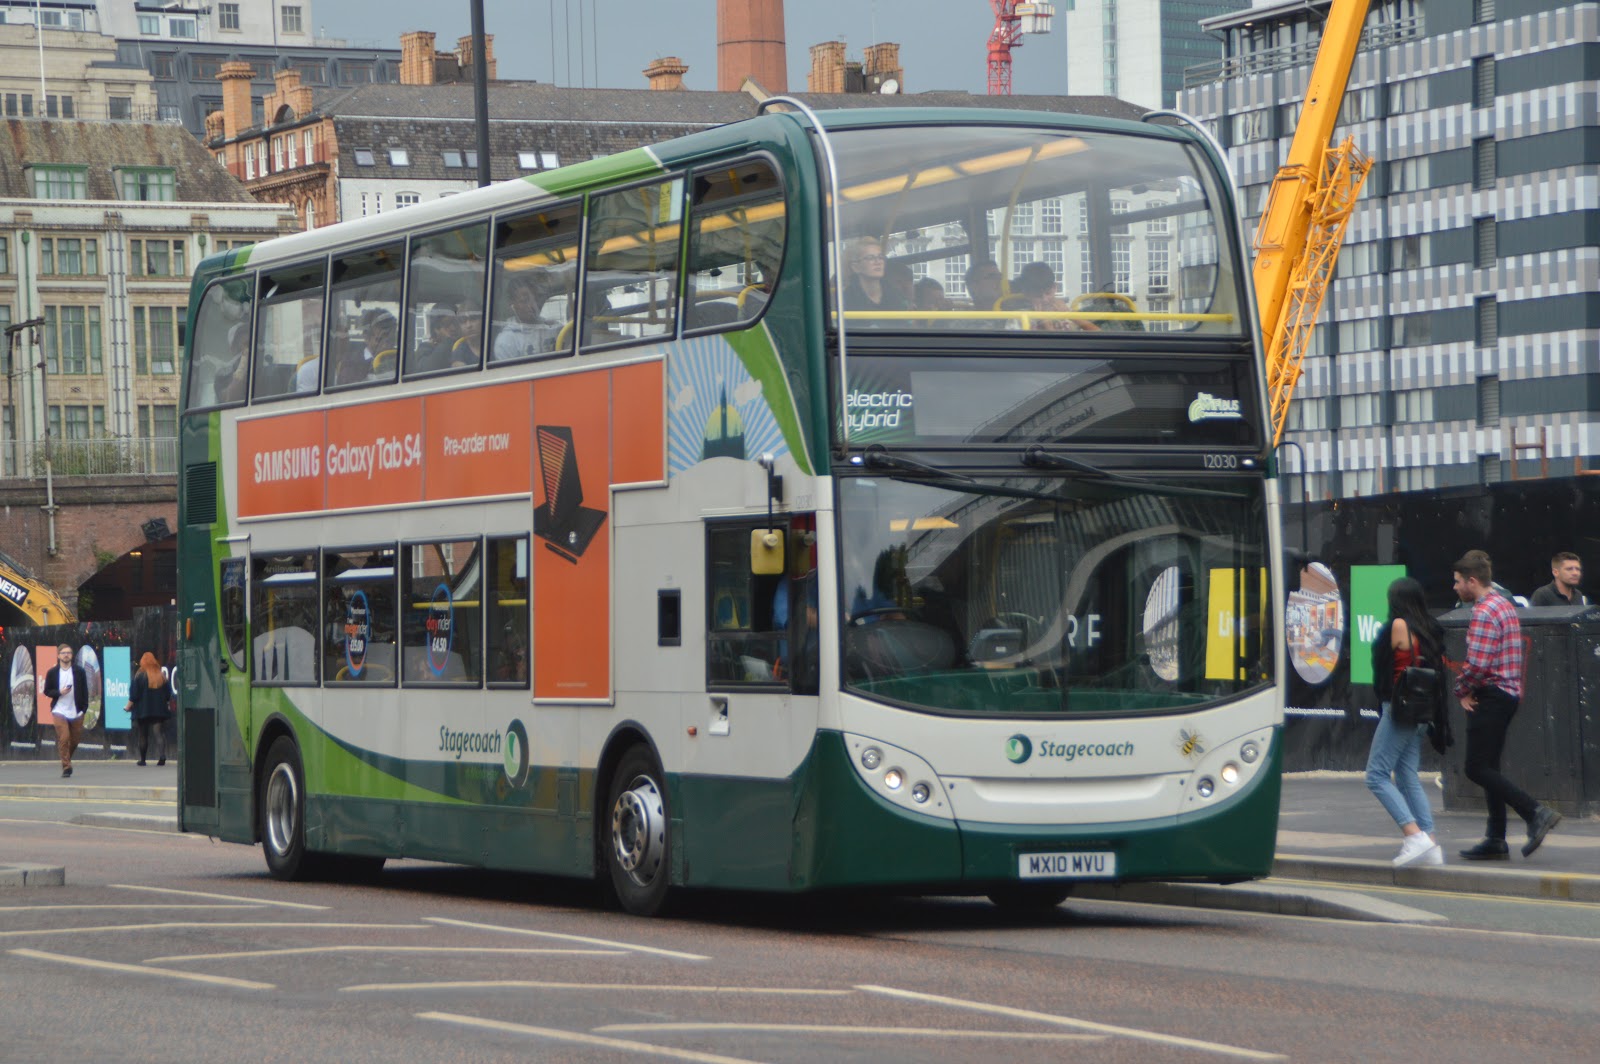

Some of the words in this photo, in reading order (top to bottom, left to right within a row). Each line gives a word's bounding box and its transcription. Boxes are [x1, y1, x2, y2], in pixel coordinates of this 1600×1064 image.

[443, 432, 487, 456] Pre-order
[488, 432, 510, 451] now
[254, 445, 320, 484] SAMSUNG
[326, 441, 376, 480] Galaxy
[376, 435, 403, 469] Tab
[404, 432, 422, 467] S4
[1203, 454, 1237, 468] 12030
[426, 614, 451, 636] dayrider
[439, 725, 502, 760] Stagecoach
[1038, 740, 1134, 761] Stagecoach
[1029, 855, 1067, 873] MX10
[1072, 855, 1104, 872] MVU
